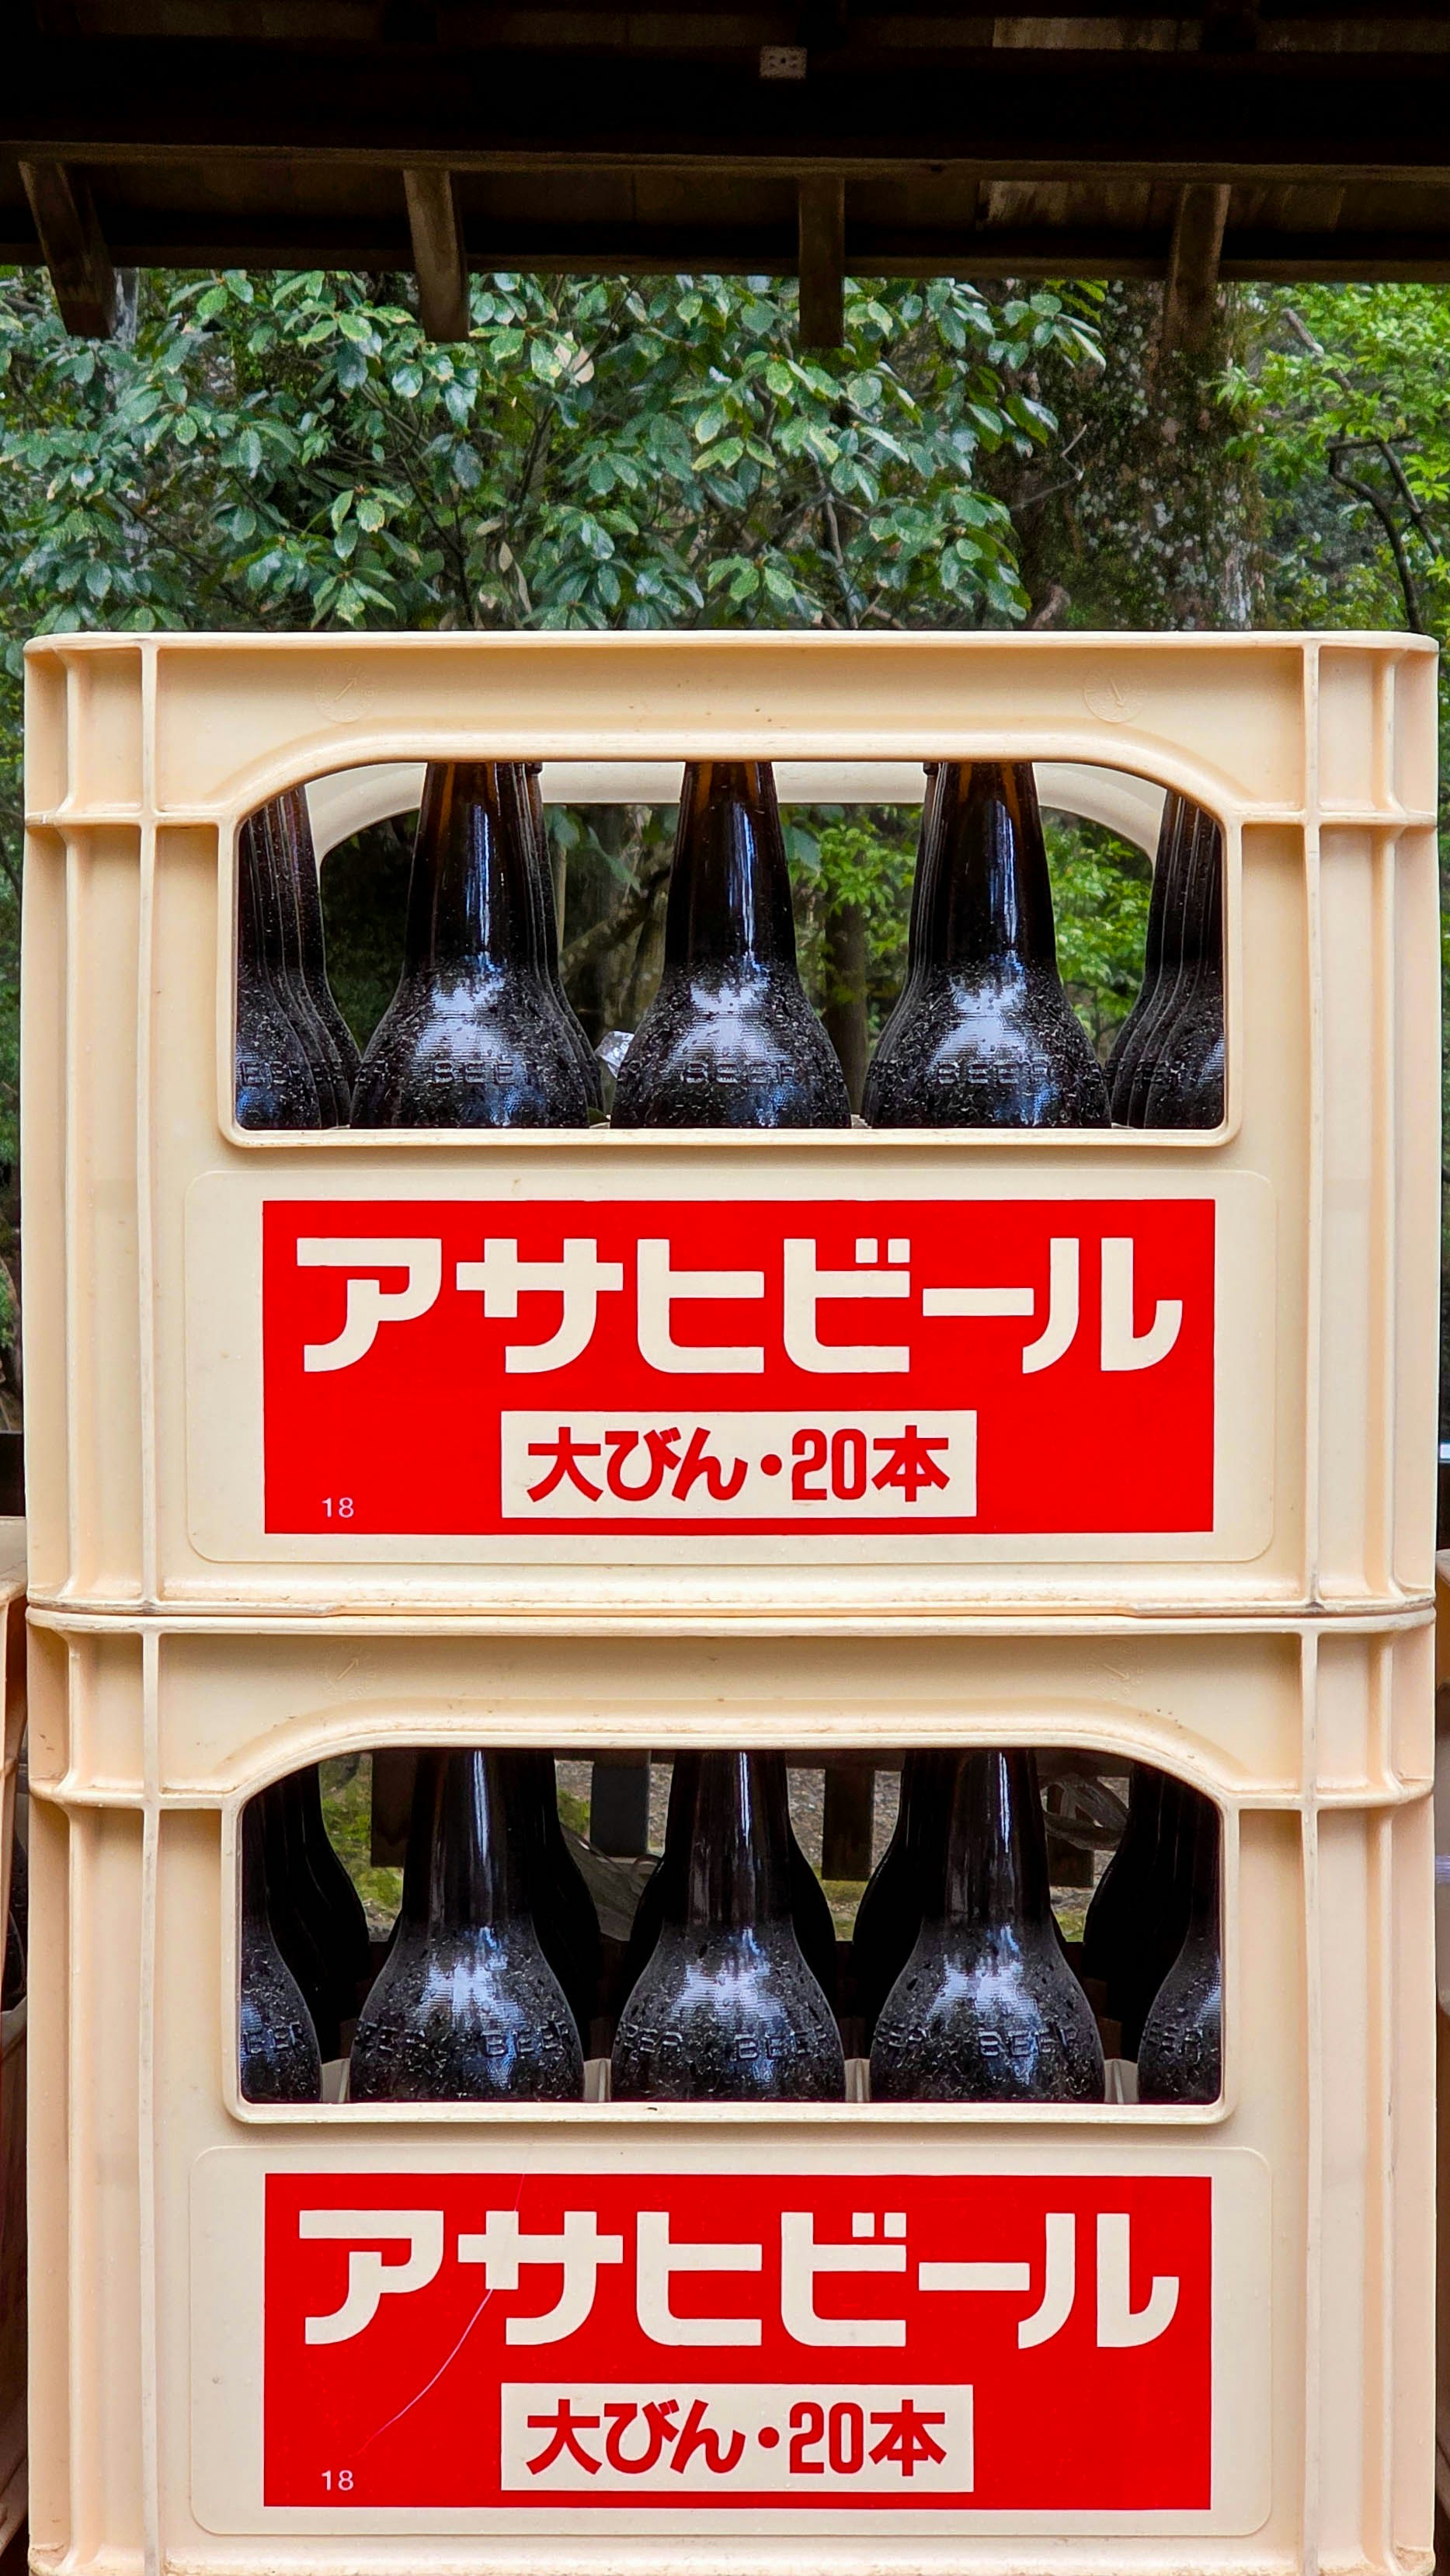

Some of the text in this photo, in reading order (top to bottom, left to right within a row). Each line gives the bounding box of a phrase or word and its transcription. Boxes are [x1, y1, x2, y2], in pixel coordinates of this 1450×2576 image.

[682, 1061, 796, 1086] BEER
[297, 1238, 1182, 1373] アサヒビール
[527, 1426, 950, 1502] 大びん・20本
[322, 1498, 354, 1518] 18
[977, 2026, 1078, 2058] BEER
[300, 2210, 1179, 2348] アサヒビール
[527, 2399, 947, 2477] 大びん・20本
[322, 2470, 354, 2491] 18
